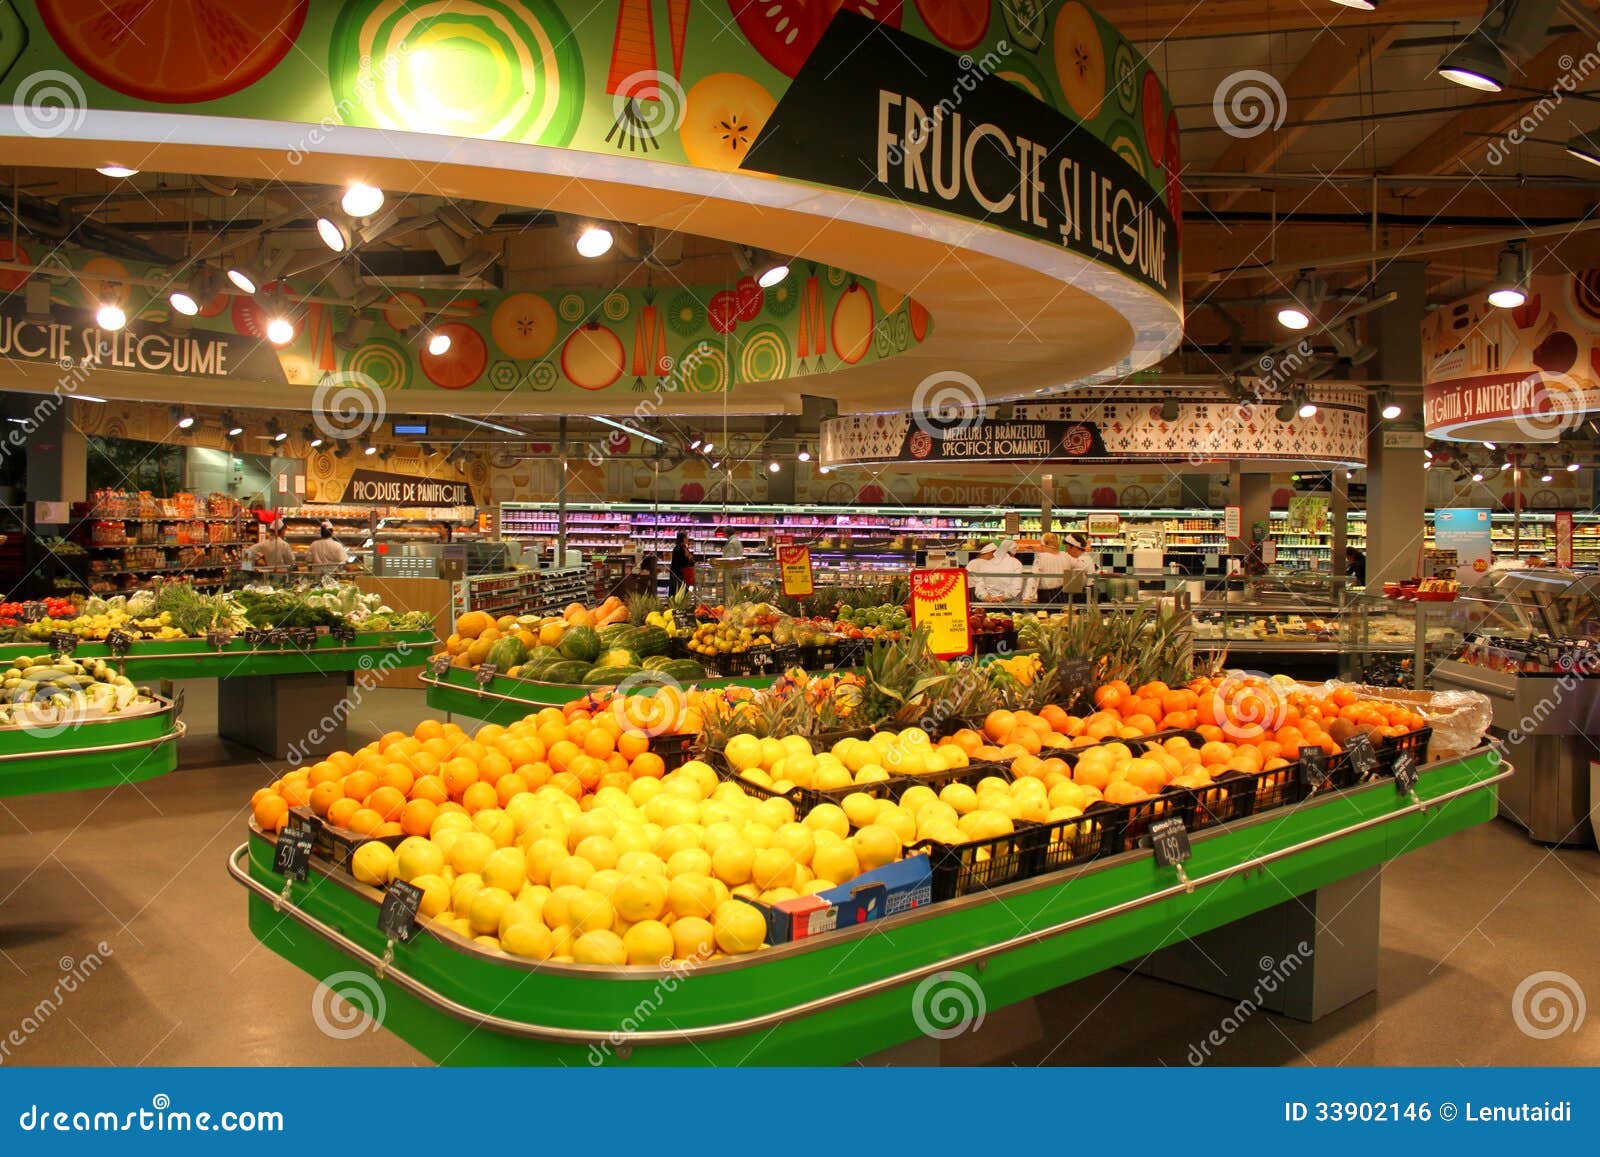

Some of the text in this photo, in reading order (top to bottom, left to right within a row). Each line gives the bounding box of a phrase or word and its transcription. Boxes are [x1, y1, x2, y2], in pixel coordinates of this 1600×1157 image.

[877, 89, 1167, 290] FRUCTE ȘI LEGUME
[112, 329, 228, 376] LEGUME
[1476, 379, 1536, 416] ANTREURI
[943, 425, 982, 441] MEZELURI
[942, 441, 992, 457] SPECIFICE
[353, 480, 401, 501] PRODUSE
[403, 483, 416, 502] DE
[934, 603, 947, 611] LIME
